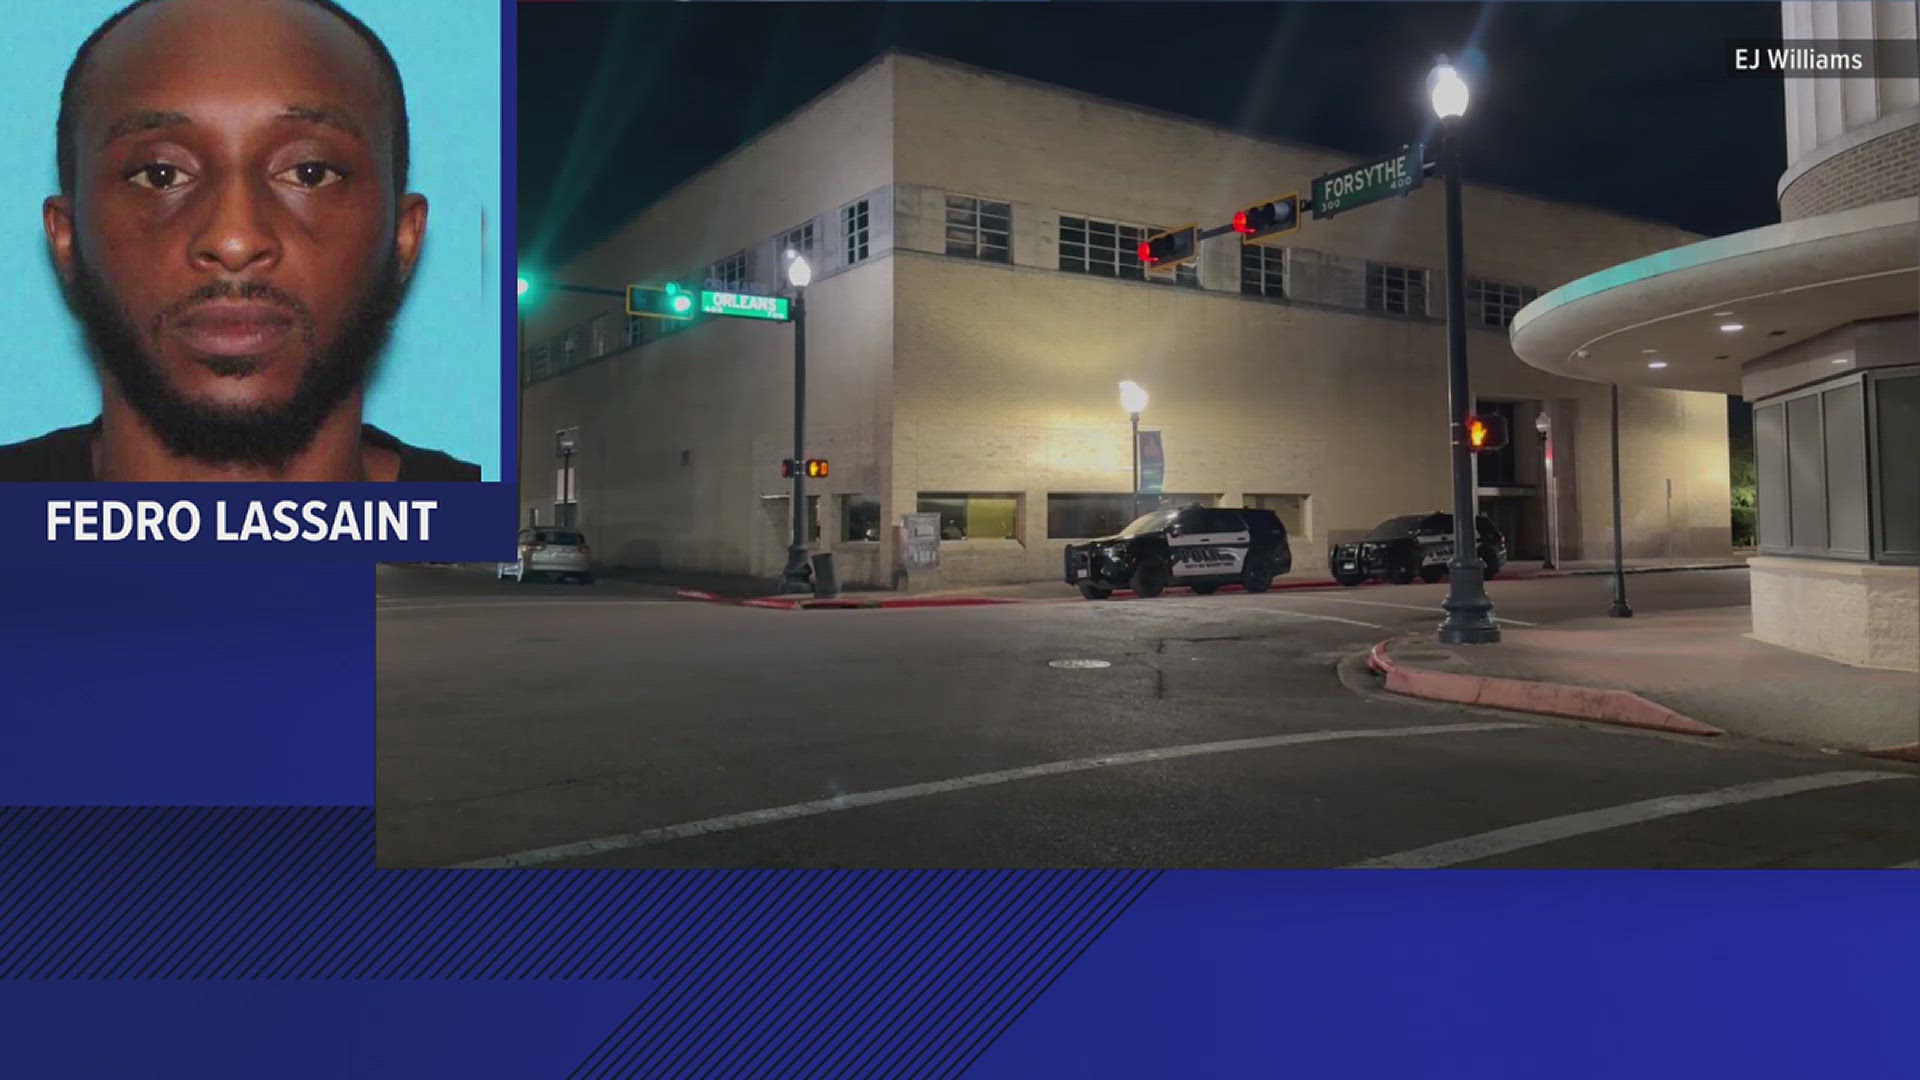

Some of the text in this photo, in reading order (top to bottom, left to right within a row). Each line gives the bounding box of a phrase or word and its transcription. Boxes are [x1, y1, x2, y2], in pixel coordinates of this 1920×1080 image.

[1325, 156, 1407, 200] FORSYTHE
[1390, 176, 1412, 189] 400
[1322, 200, 1341, 212] 300
[712, 292, 776, 311] ORLEANS
